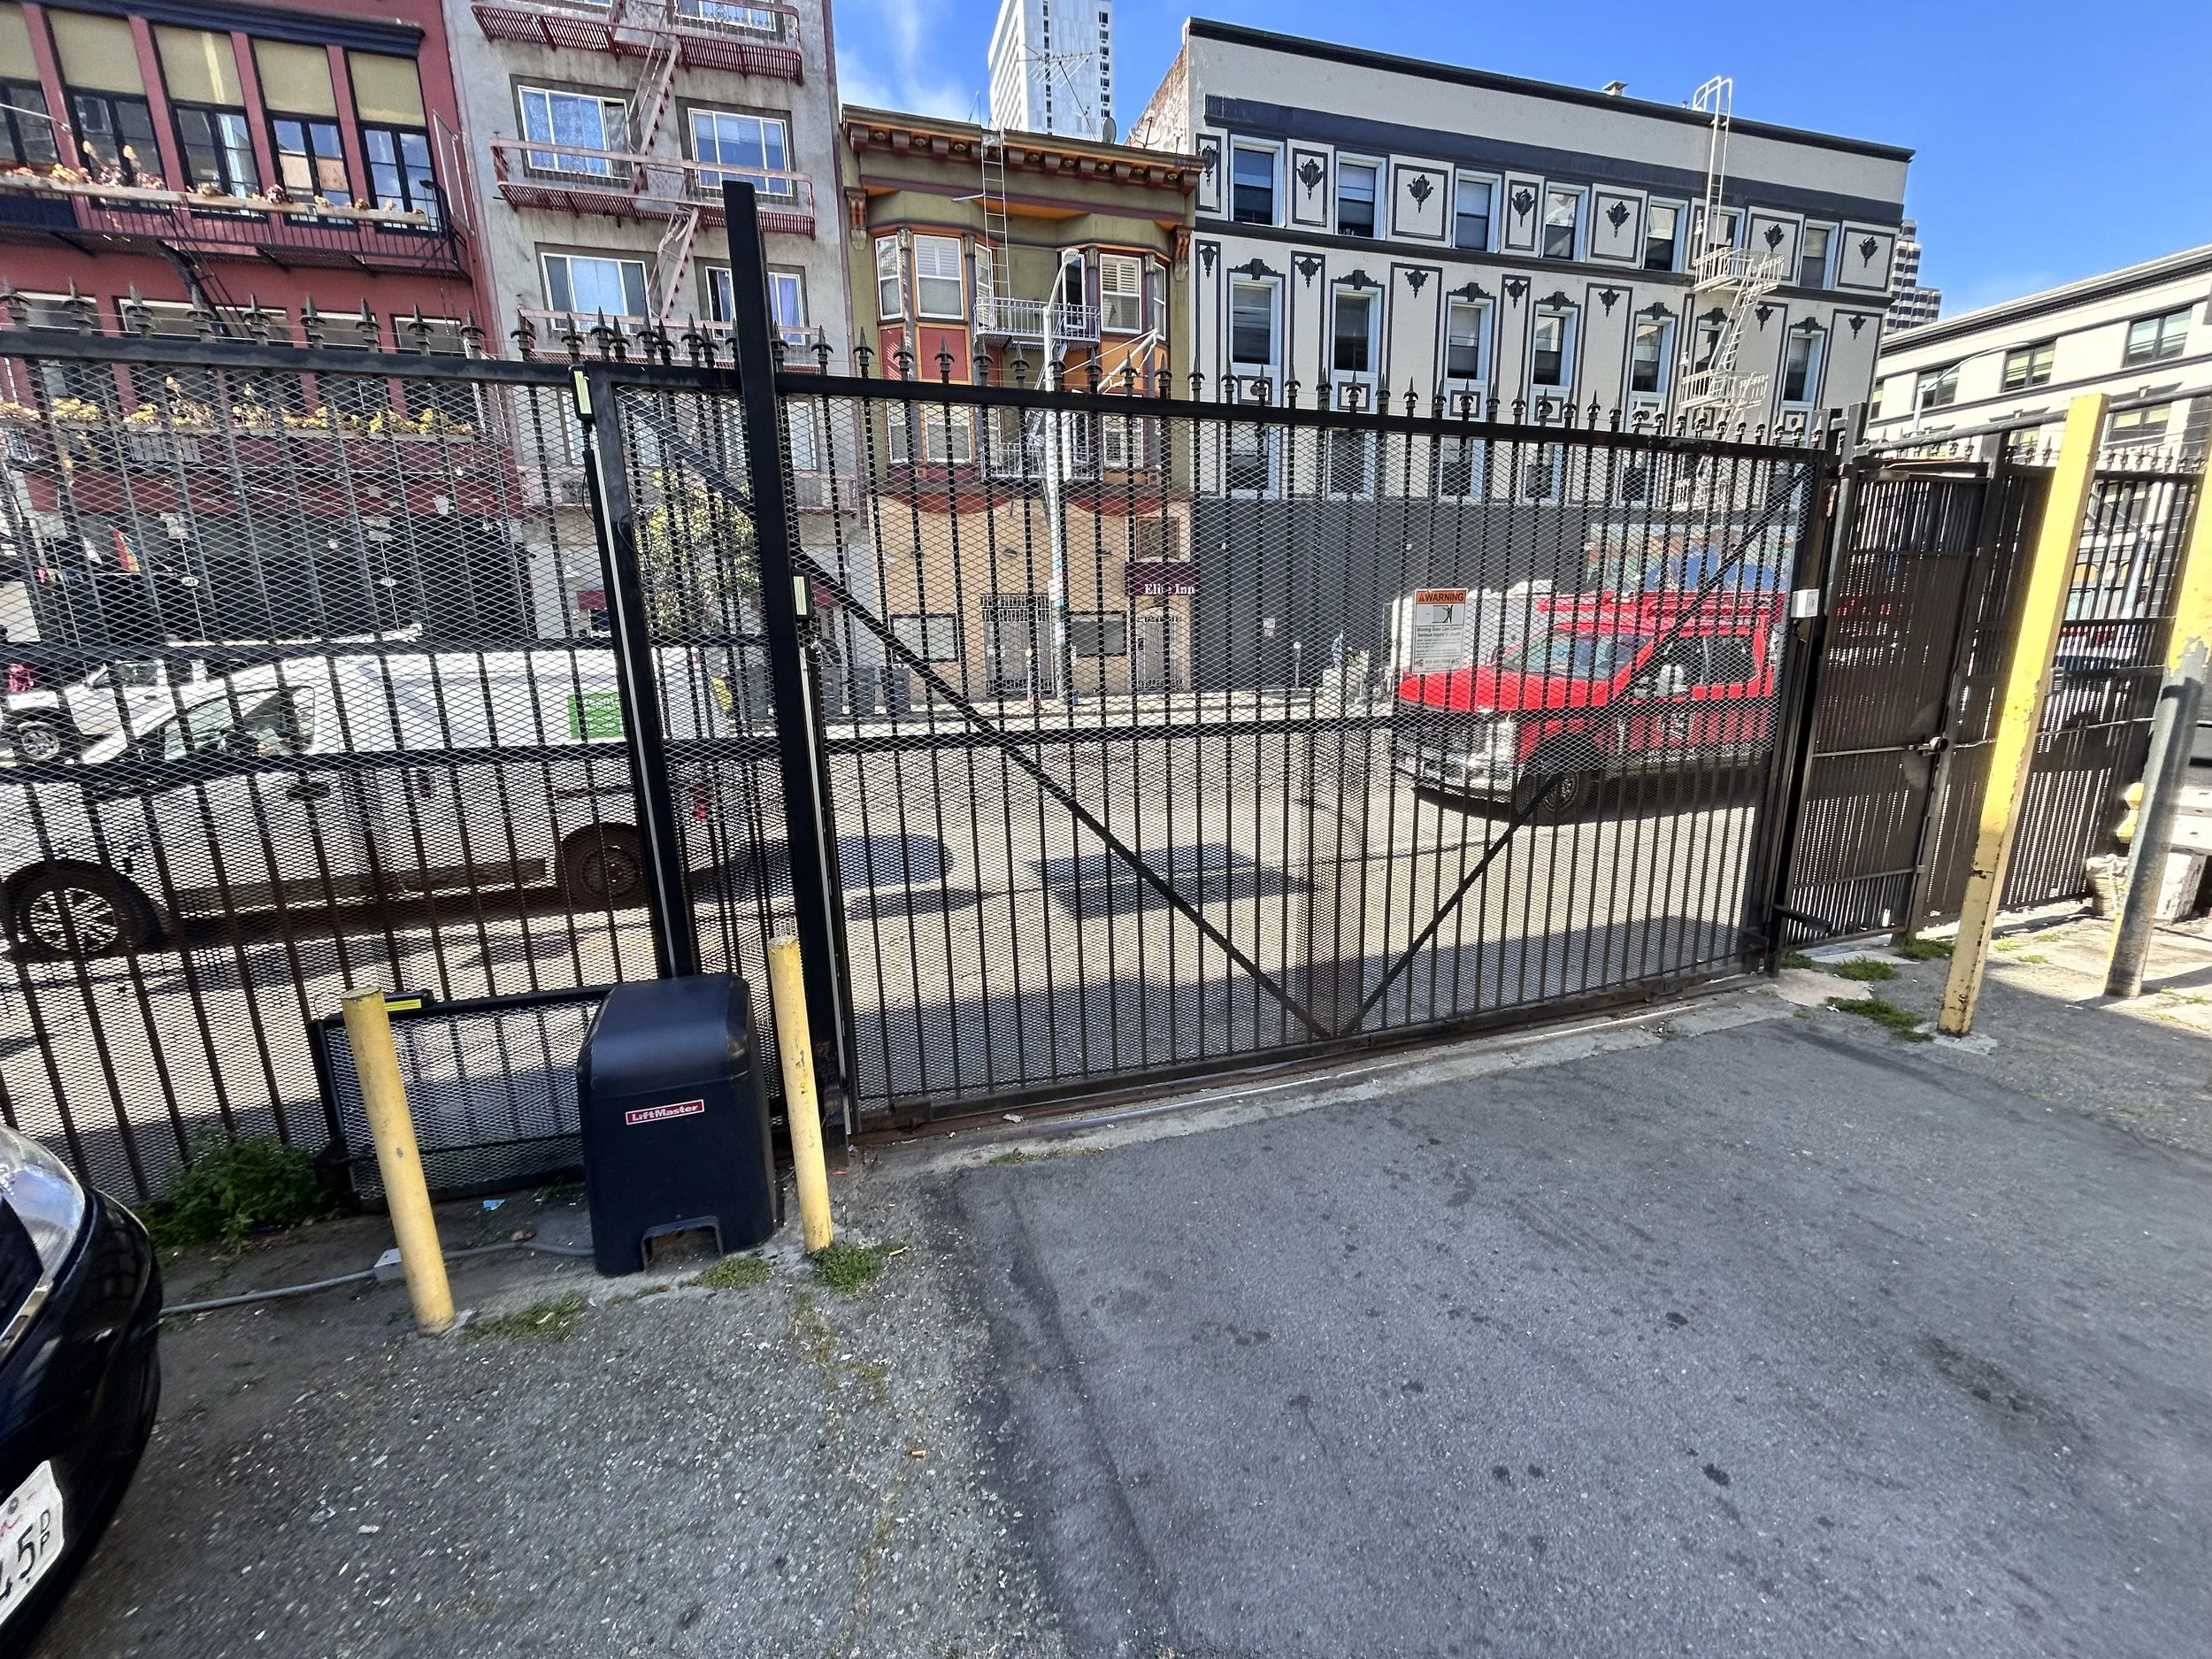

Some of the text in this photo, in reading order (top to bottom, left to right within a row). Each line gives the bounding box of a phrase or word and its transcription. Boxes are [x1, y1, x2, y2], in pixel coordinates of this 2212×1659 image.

[1174, 583, 1195, 595] Inn
[1425, 592, 1464, 602] WARNING
[632, 1105, 698, 1122] LiftMaster
